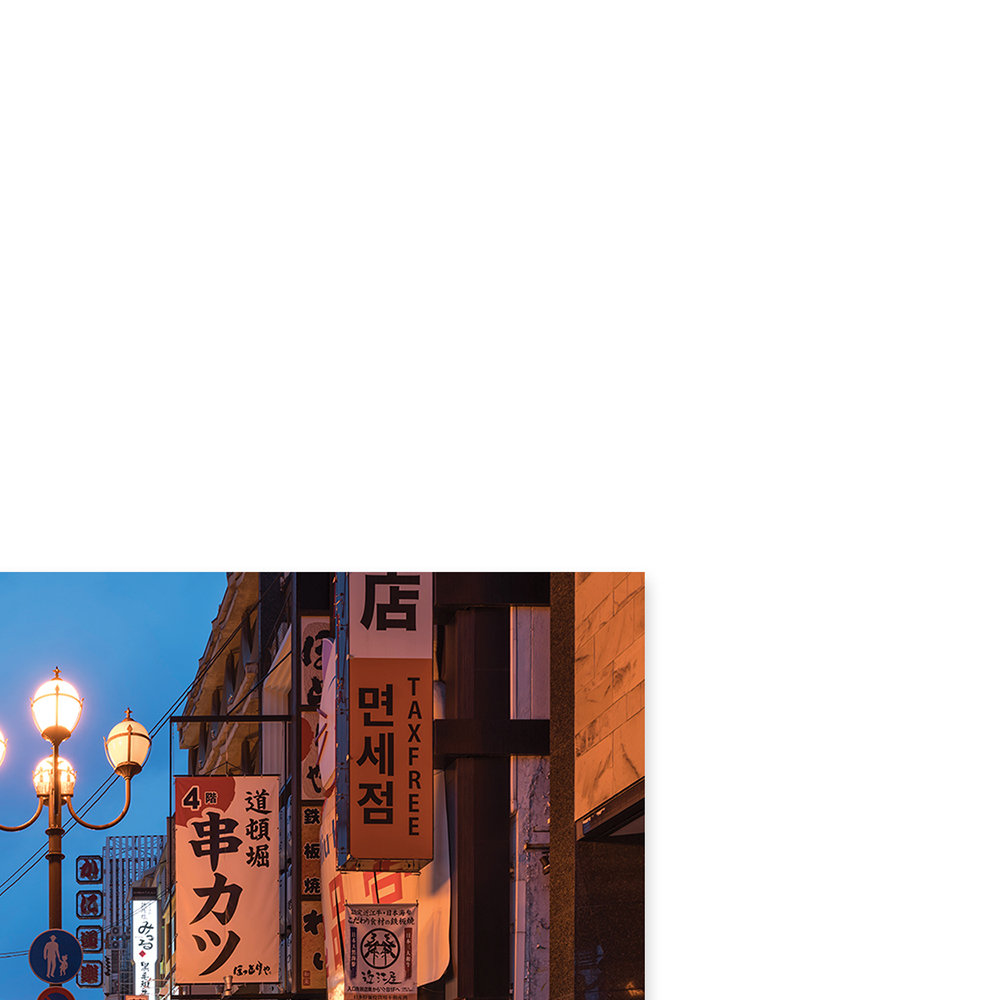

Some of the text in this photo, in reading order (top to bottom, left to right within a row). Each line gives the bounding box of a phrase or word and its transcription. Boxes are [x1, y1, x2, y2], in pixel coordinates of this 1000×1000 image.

[183, 787, 218, 810] 4階
[356, 683, 394, 825] 면세점
[407, 677, 422, 836] TAXFREE
[188, 811, 243, 976] 串カツ
[244, 789, 272, 868] 道頓堀
